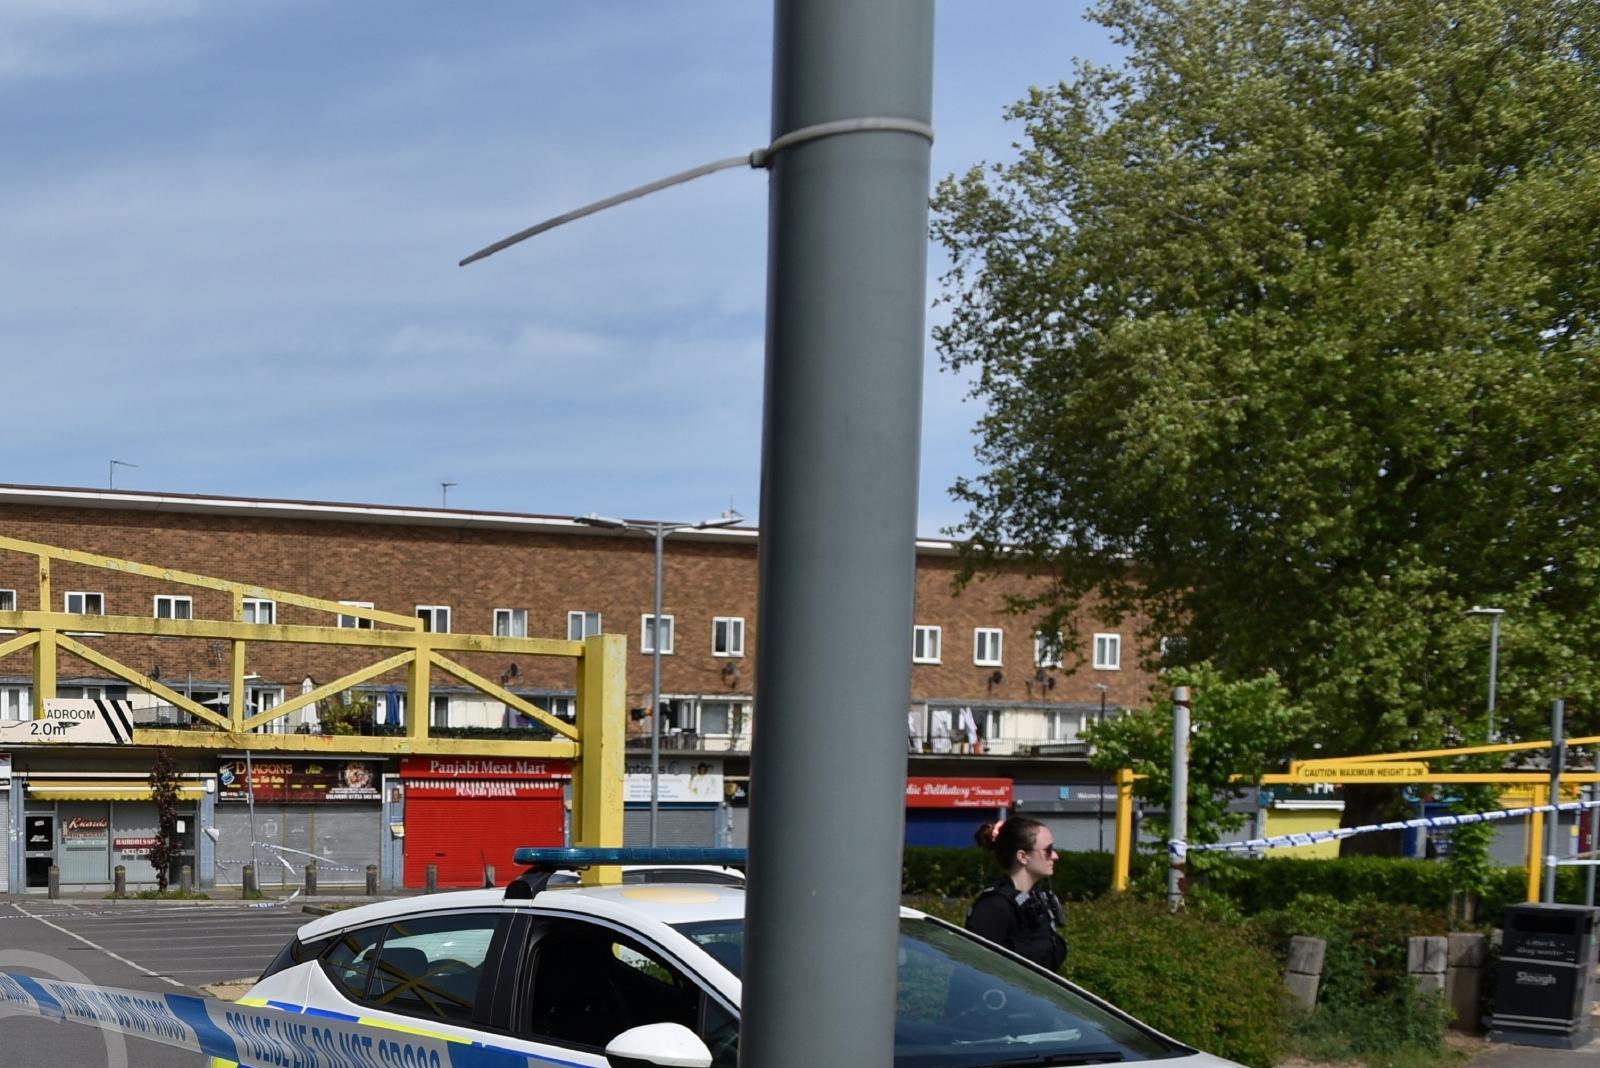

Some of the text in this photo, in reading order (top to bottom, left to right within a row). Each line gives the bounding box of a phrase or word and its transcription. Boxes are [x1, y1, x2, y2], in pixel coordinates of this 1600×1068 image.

[30, 722, 66, 736] 2.0m
[235, 761, 293, 775] DAGON'S
[430, 760, 546, 776] Panjabi Meat Mart
[1304, 768, 1337, 777] CAUTION
[1340, 767, 1374, 777] MAXIMUM
[1377, 767, 1404, 776] HEIGHT
[1517, 971, 1556, 985] Slough
[225, 1011, 289, 1068] POLICE
